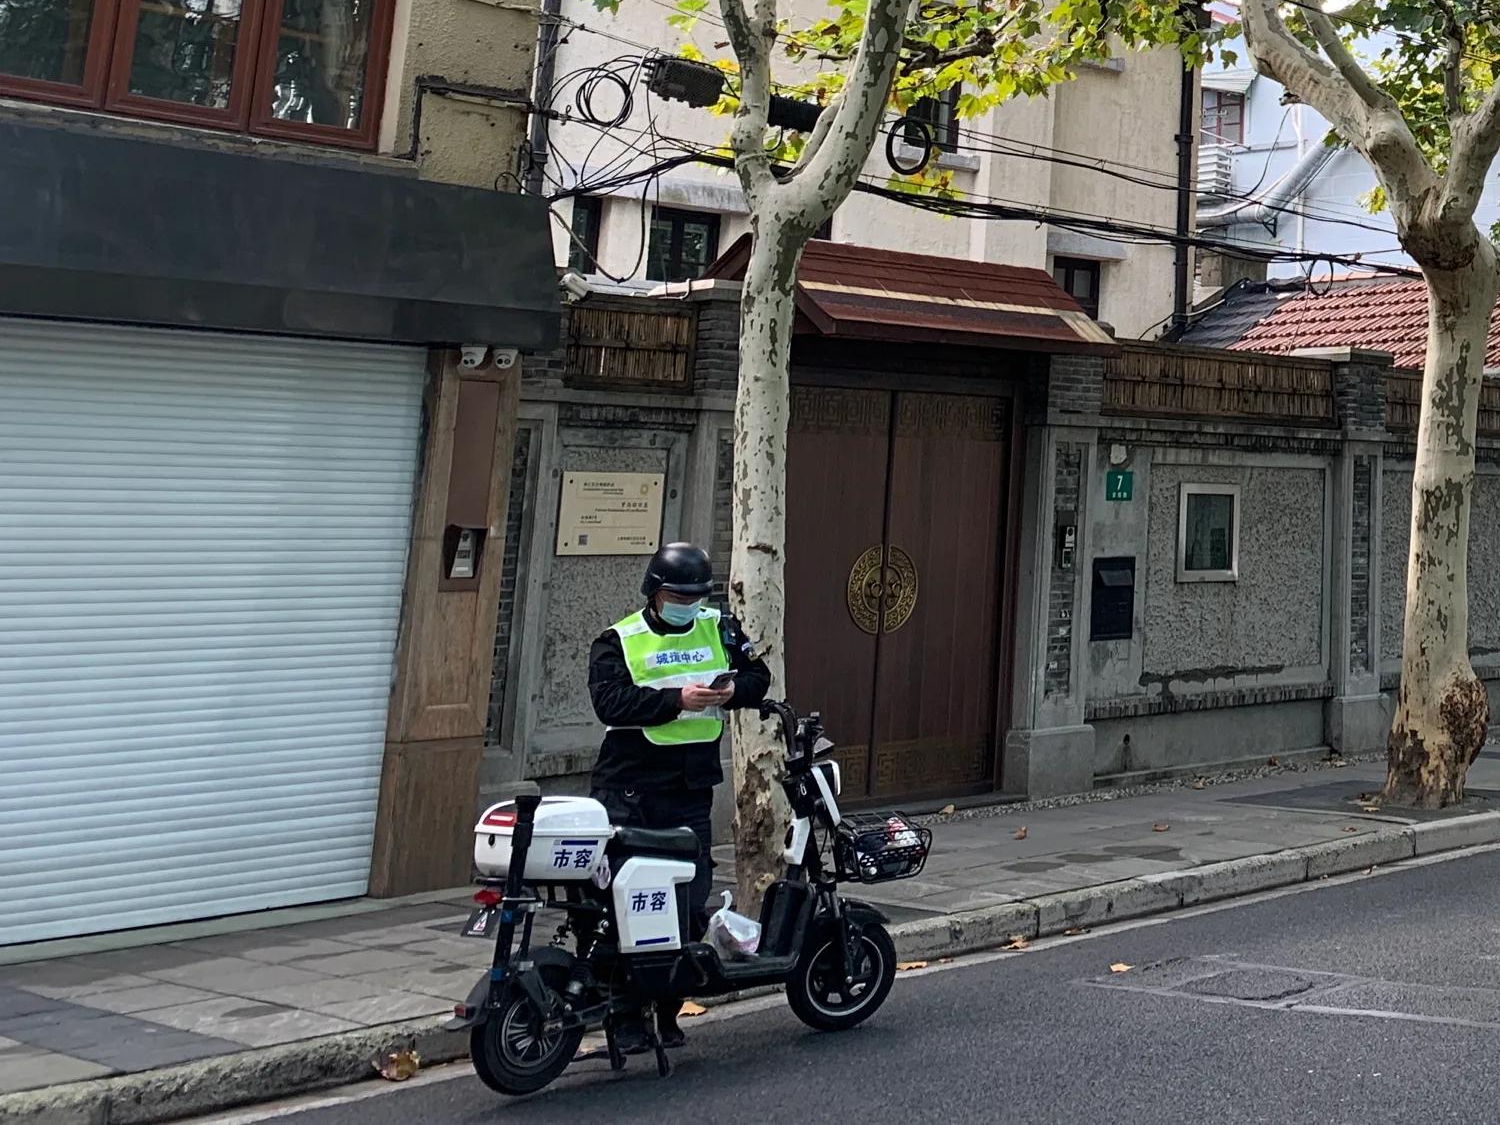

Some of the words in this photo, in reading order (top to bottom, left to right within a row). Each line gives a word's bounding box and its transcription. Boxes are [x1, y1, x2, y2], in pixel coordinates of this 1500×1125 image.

[1116, 474, 1124, 490] 7
[553, 849, 592, 869] 市容
[631, 891, 667, 913] 市容
